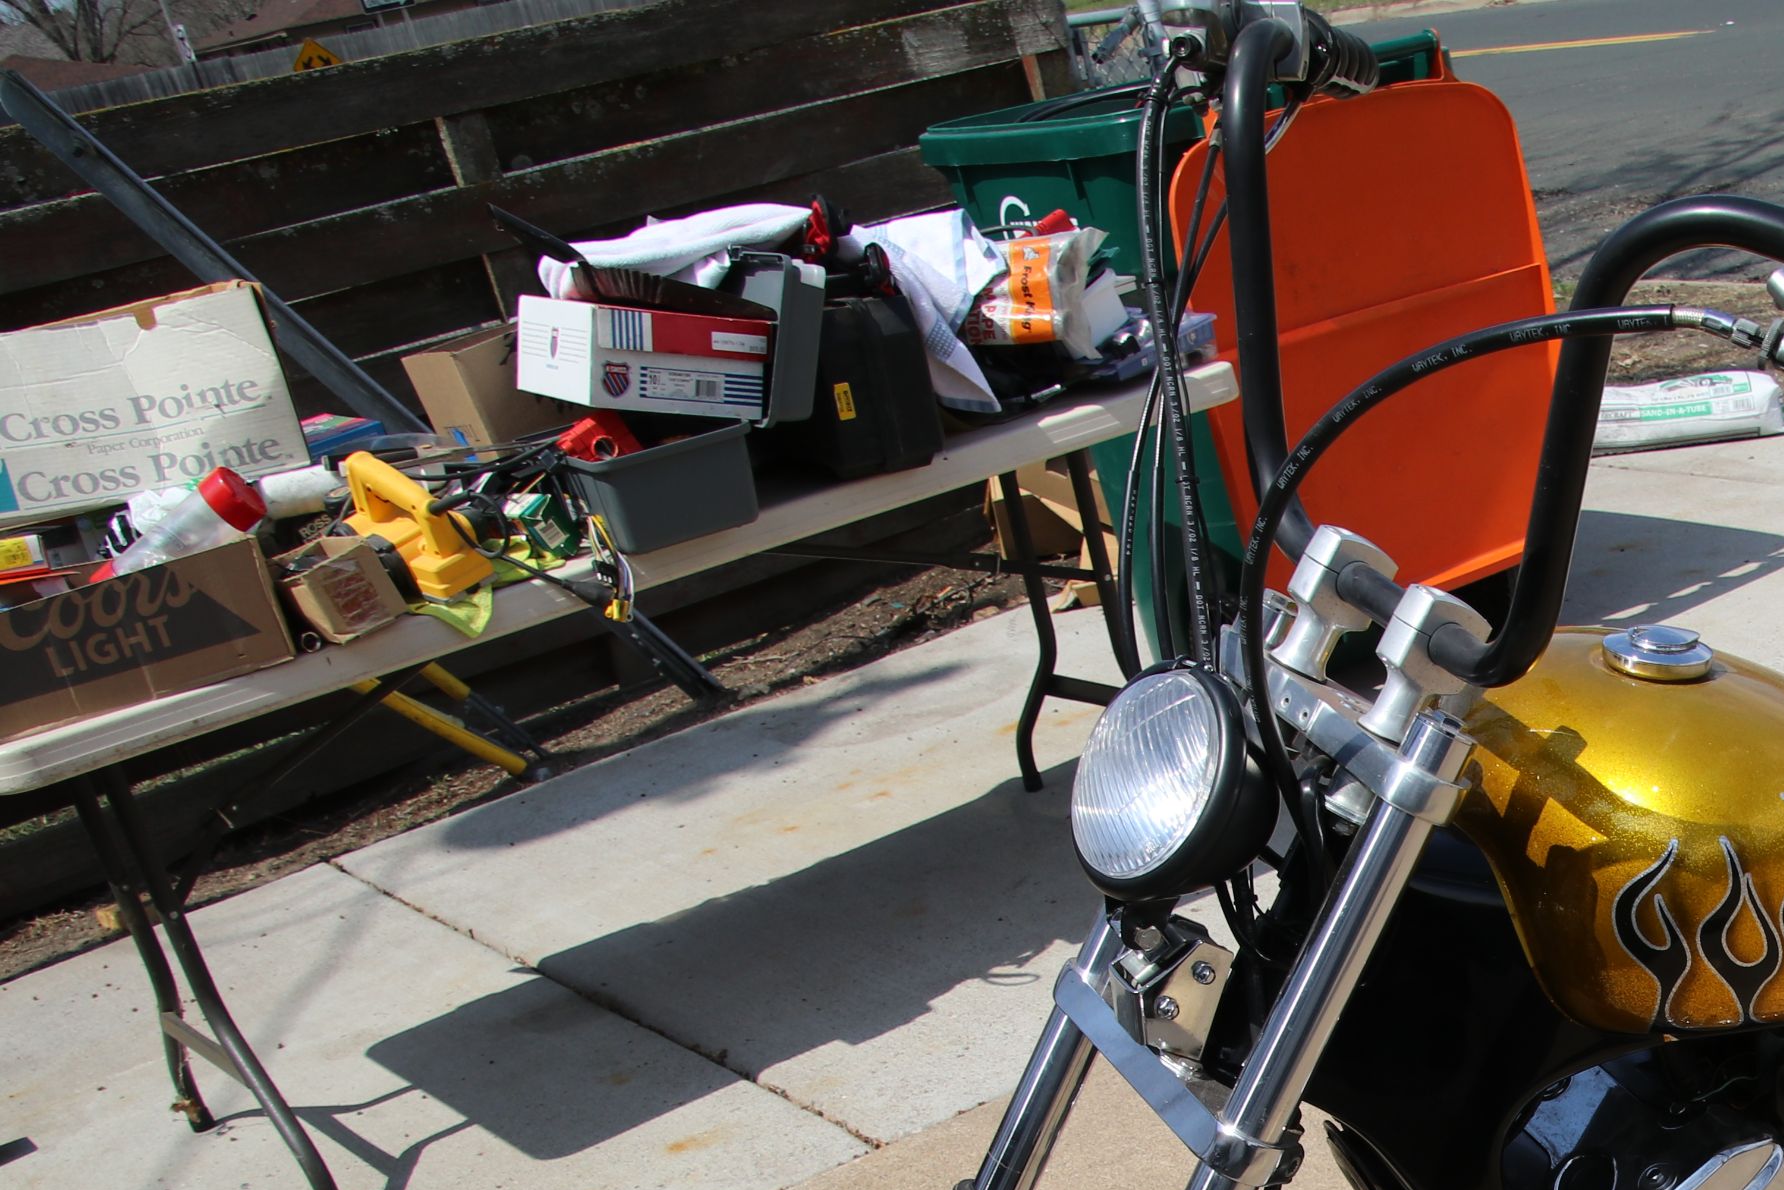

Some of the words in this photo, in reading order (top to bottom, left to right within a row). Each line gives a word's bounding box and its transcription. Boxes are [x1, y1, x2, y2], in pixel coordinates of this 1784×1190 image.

[1145, 238, 1154, 253] DOT
[1021, 265, 1033, 298] Frost
[1162, 356, 1172, 372] DOT
[0, 407, 121, 442] Cross
[127, 379, 261, 425] Pointe
[87, 441, 126, 456] Paper
[129, 426, 205, 449] Corporation
[1296, 445, 1314, 461] INC.
[17, 465, 141, 502] Cross
[147, 438, 283, 483] Pointe
[1186, 520, 1197, 543] 3/02
[1190, 547, 1200, 562] 1/8
[1191, 565, 1201, 577] HL
[0, 566, 193, 651] Coors
[1195, 594, 1205, 610] DOT
[46, 614, 172, 678] LIGHT
